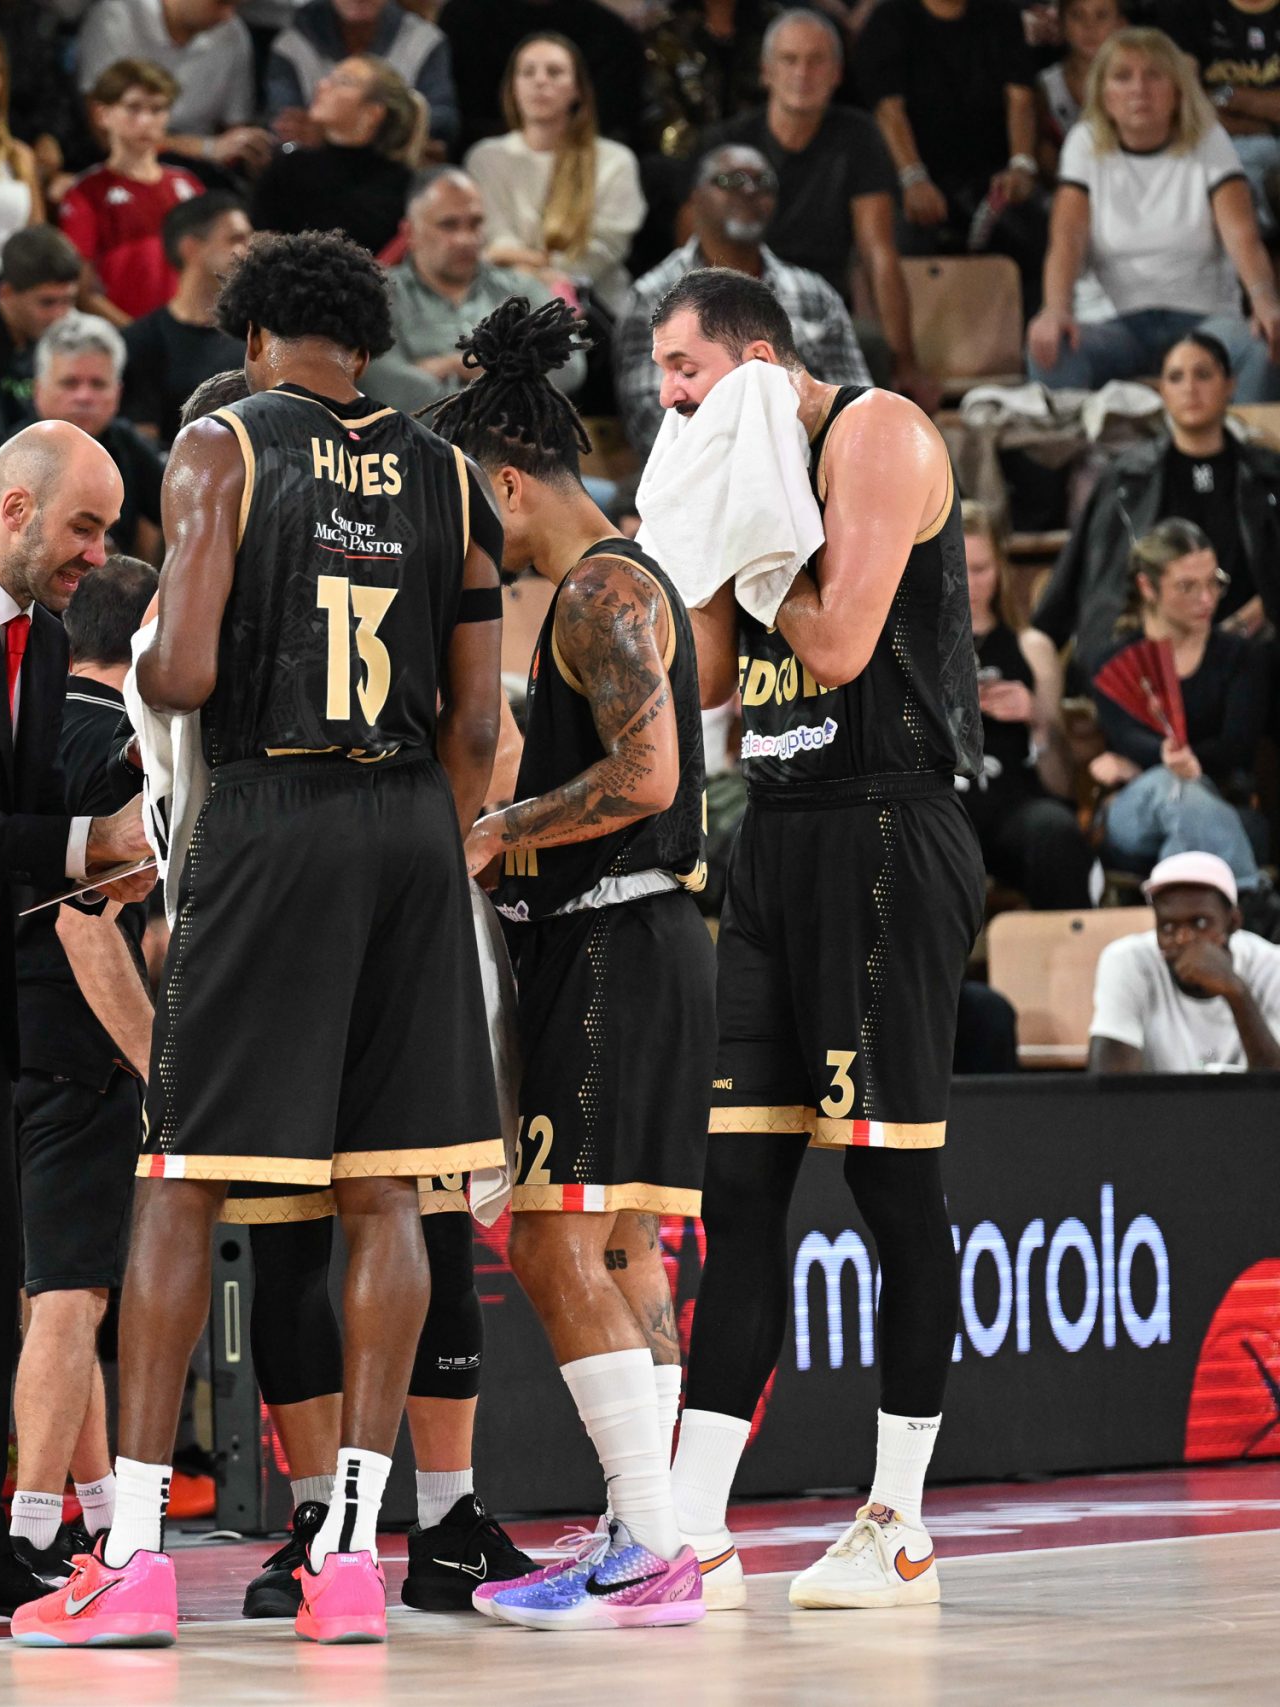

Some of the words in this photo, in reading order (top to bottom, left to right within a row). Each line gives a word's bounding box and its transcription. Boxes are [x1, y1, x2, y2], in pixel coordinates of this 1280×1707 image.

[311, 437, 402, 496] HAYES
[348, 534, 403, 555] PASTOR
[317, 575, 399, 726] 13
[820, 1049, 857, 1118] 3
[794, 1182, 1171, 1372] morola
